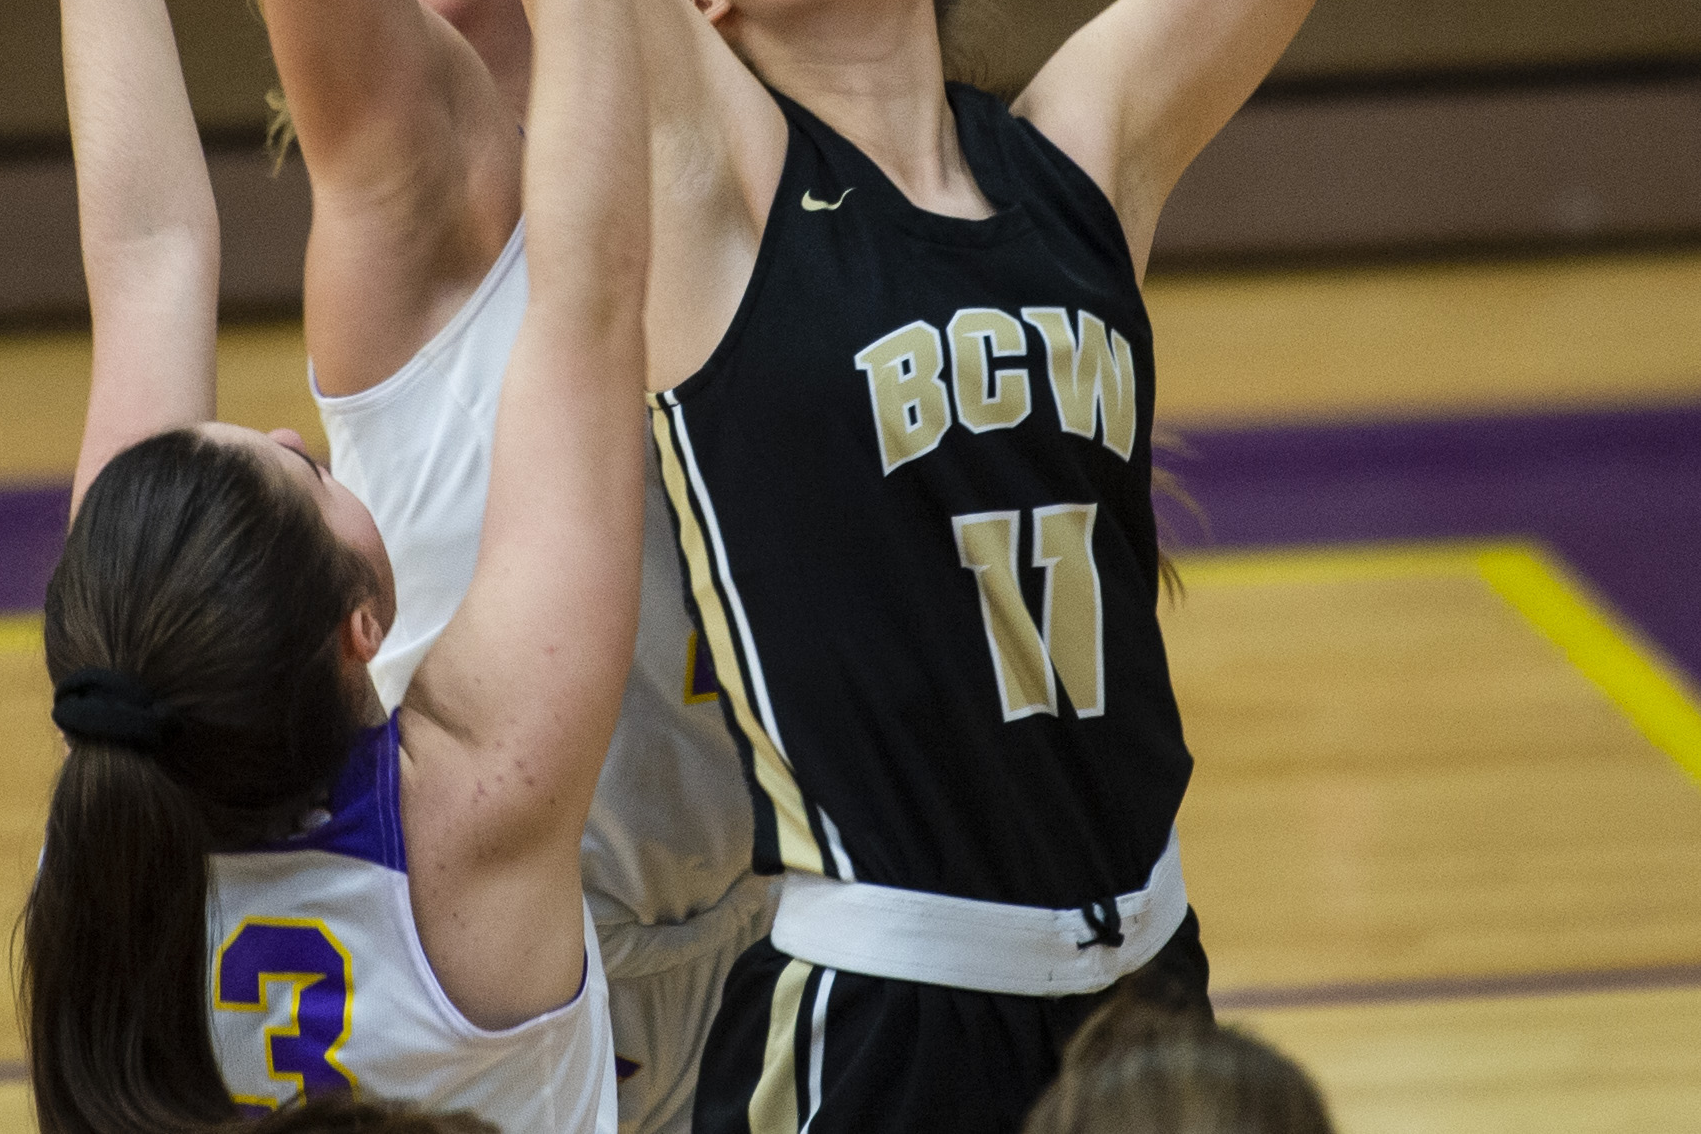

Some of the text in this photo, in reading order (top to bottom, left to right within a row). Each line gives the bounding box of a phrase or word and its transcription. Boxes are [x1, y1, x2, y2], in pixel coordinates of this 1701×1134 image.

[854, 306, 1136, 477] BCW
[951, 502, 1105, 723] 11
[213, 915, 362, 1114] 3
